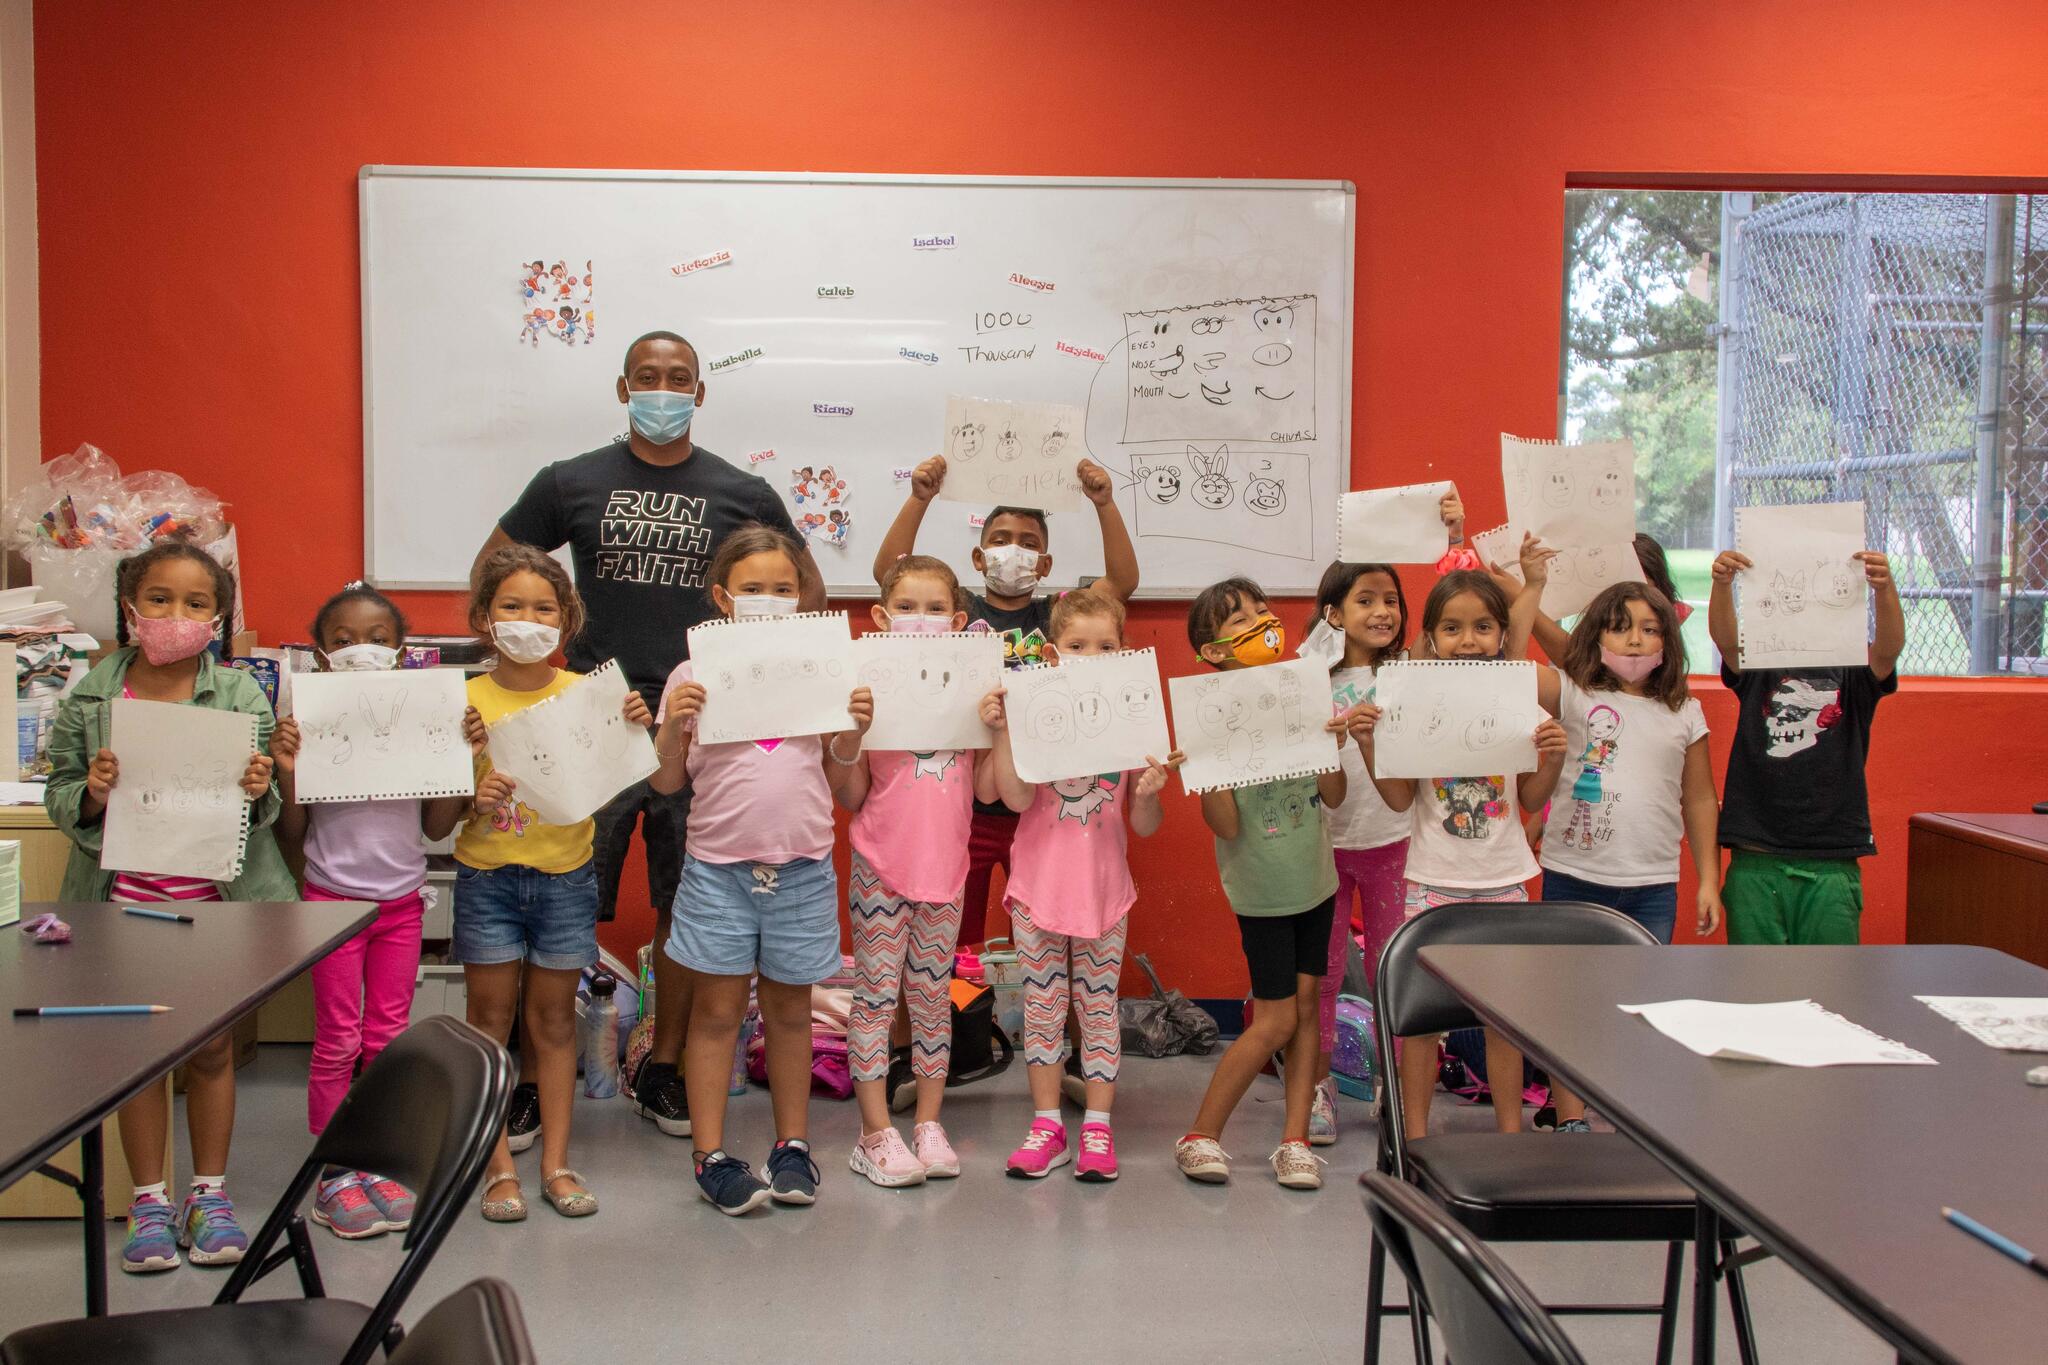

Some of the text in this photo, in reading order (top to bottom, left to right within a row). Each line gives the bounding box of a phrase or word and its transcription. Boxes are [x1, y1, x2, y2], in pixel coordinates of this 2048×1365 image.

[912, 235, 956, 248] Isabel
[671, 250, 732, 276] Victoria
[817, 285, 855, 297] Caleb
[975, 311, 1033, 331] 1000
[1131, 340, 1156, 350] EYES
[708, 346, 763, 372] Isabella
[899, 346, 940, 363] Jacob
[957, 343, 1037, 364] Thousand
[1131, 359, 1156, 370] NOSE
[1133, 384, 1165, 398] MOUTH
[1270, 430, 1311, 442] CHIVAS
[750, 449, 775, 463] Eva
[604, 489, 707, 524] RUN
[600, 519, 712, 555] WITH
[596, 550, 713, 588] FAITH
[1603, 791, 1623, 803] me
[1597, 816, 1613, 827] my
[1594, 826, 1616, 842] bff
